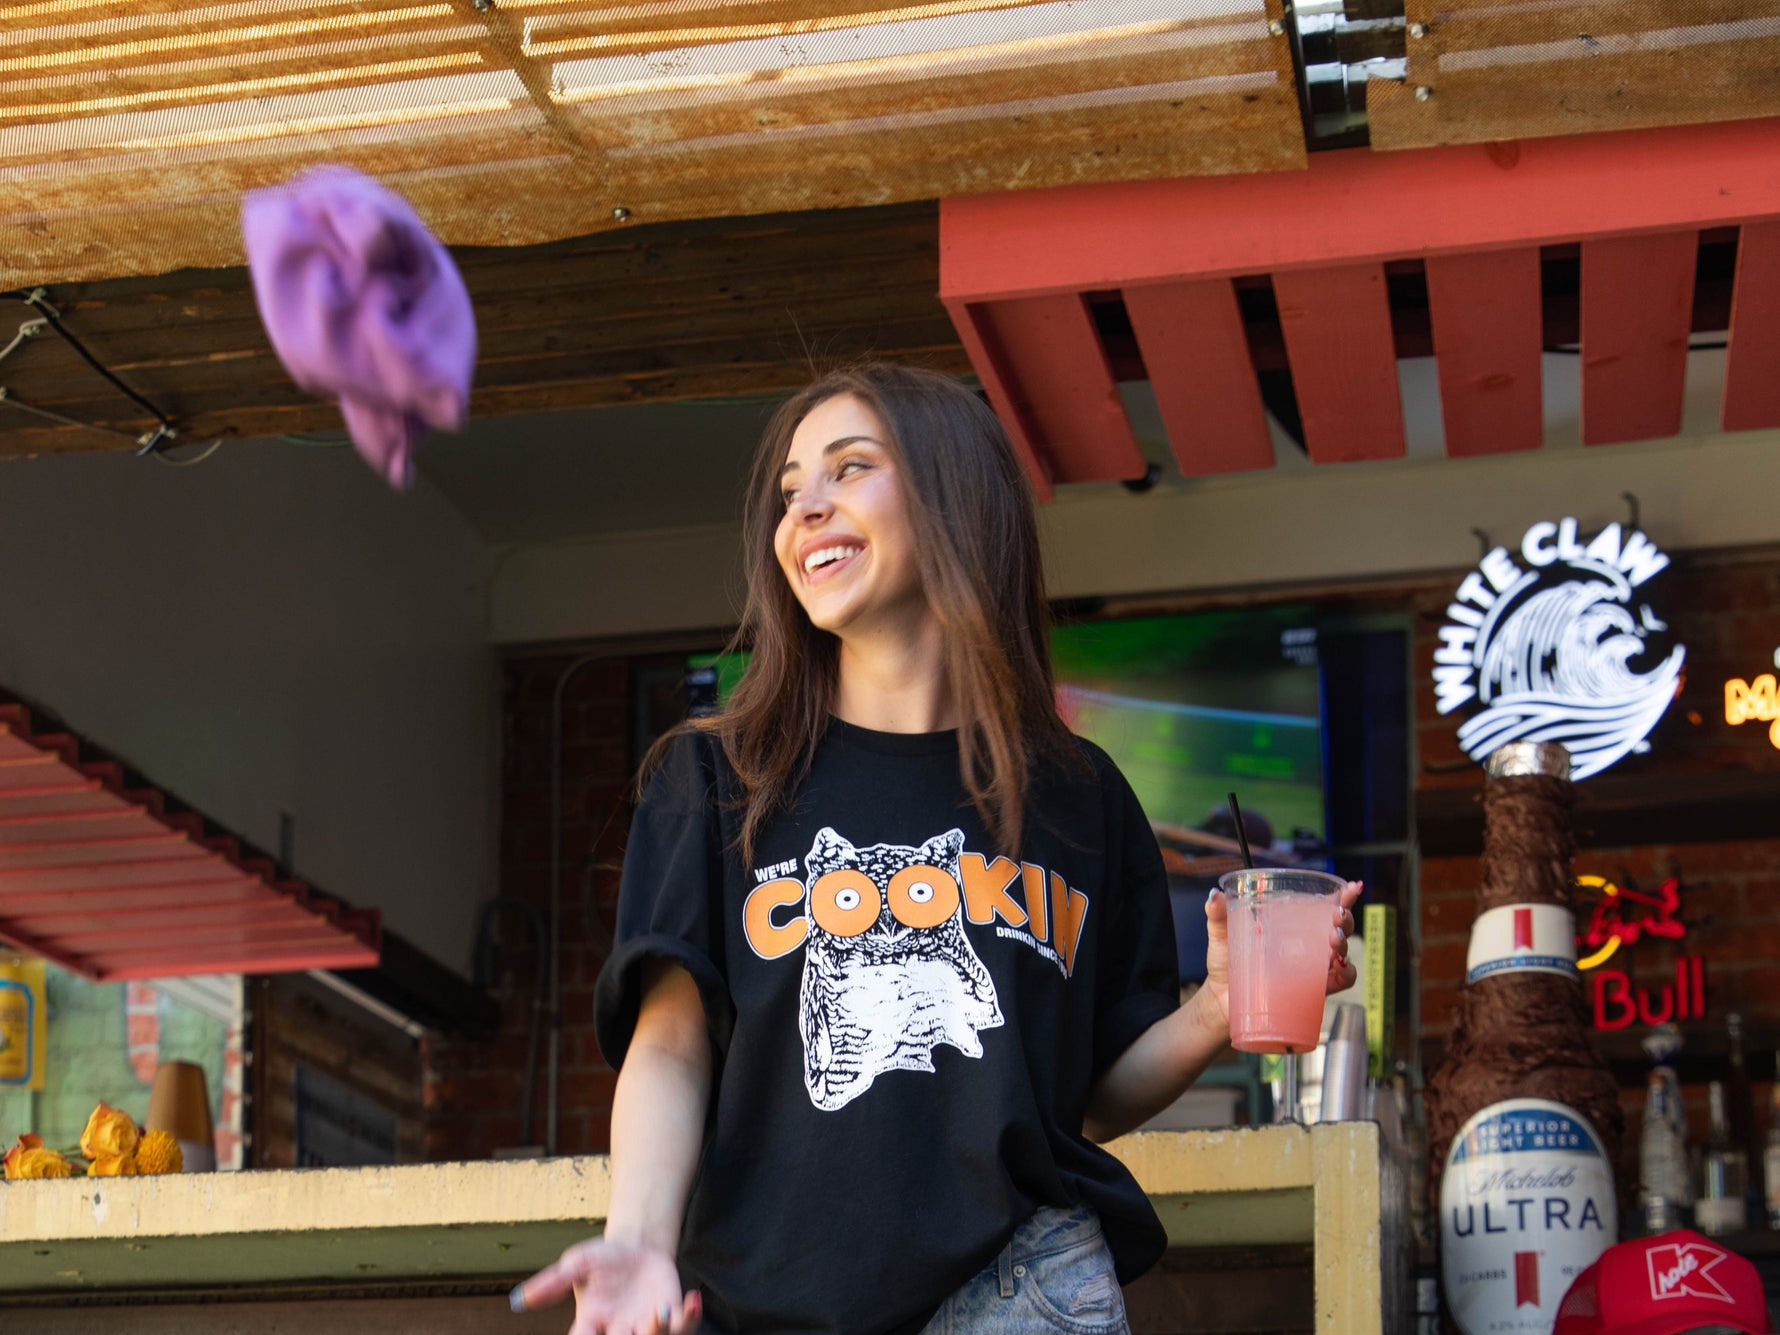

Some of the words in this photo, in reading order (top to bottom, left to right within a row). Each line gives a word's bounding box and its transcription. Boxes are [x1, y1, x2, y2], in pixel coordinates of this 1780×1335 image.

[1432, 546, 1523, 715] WHITE
[1521, 516, 1671, 588] CLAW
[754, 858, 798, 882] WE'RE
[743, 852, 1089, 978] COOKIN
[996, 926, 1036, 949] DRINKIN
[1593, 955, 1704, 1031] Bull
[1533, 1134, 1580, 1148] BEER
[1466, 1163, 1578, 1196] Michelob
[1453, 1197, 1604, 1238] ULTRA
